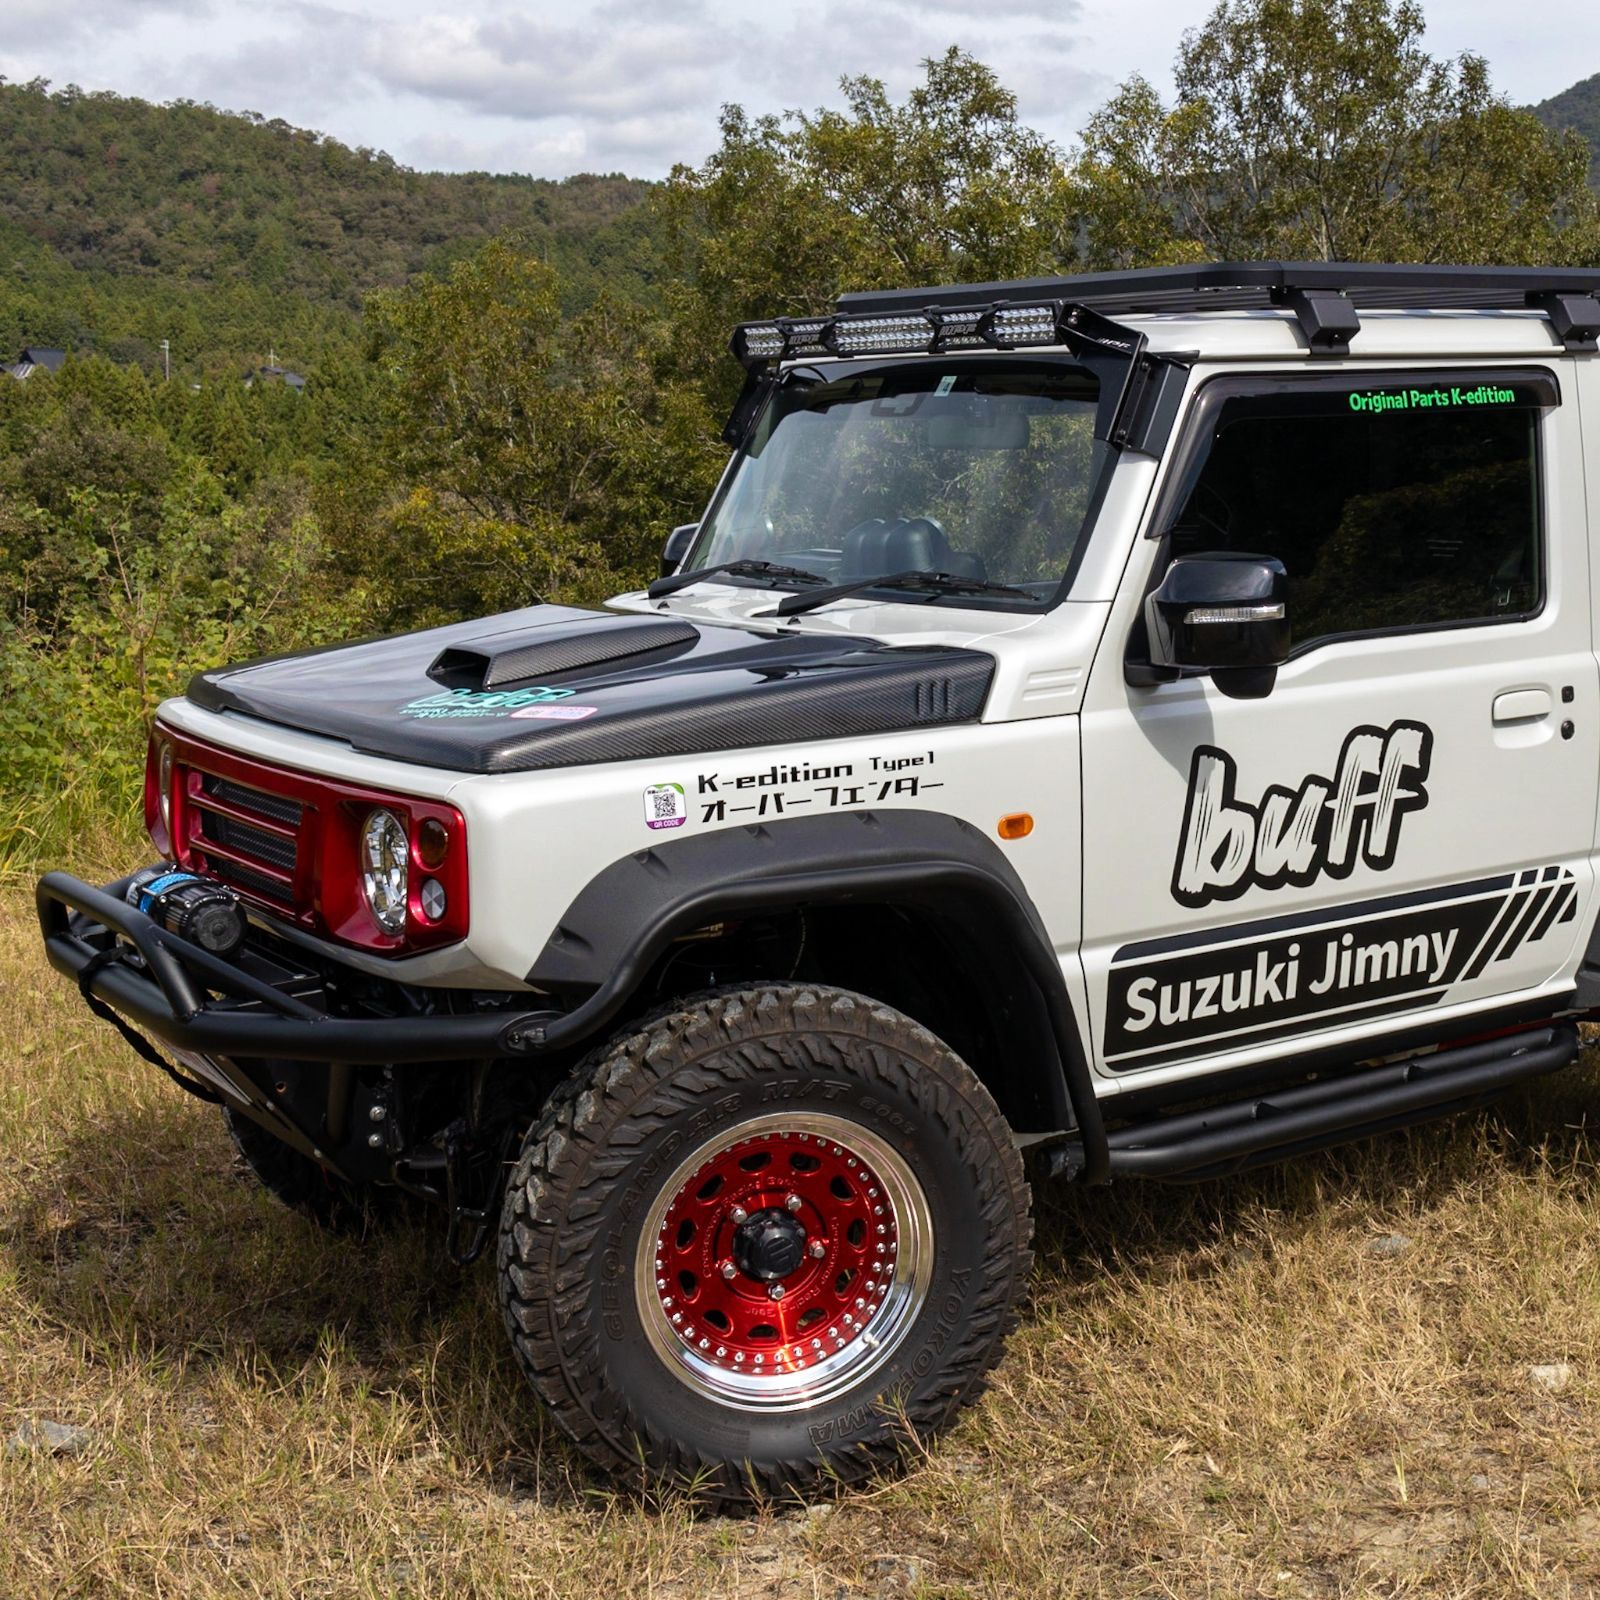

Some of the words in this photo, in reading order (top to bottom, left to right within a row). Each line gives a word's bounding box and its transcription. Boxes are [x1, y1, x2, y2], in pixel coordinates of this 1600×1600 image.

[1349, 390, 1408, 413] Original
[1410, 389, 1449, 407] Parts
[1450, 386, 1516, 405] K-edition
[697, 762, 853, 794] K-edition
[869, 751, 934, 772] Type1
[700, 776, 944, 823] オーバーフェンダー
[1170, 719, 1434, 909] buff
[1122, 942, 1301, 1033] Suzuki
[1308, 928, 1459, 995] Jimny
[602, 1092, 743, 1342] GEOLANDAR
[762, 1079, 853, 1102] M/T
